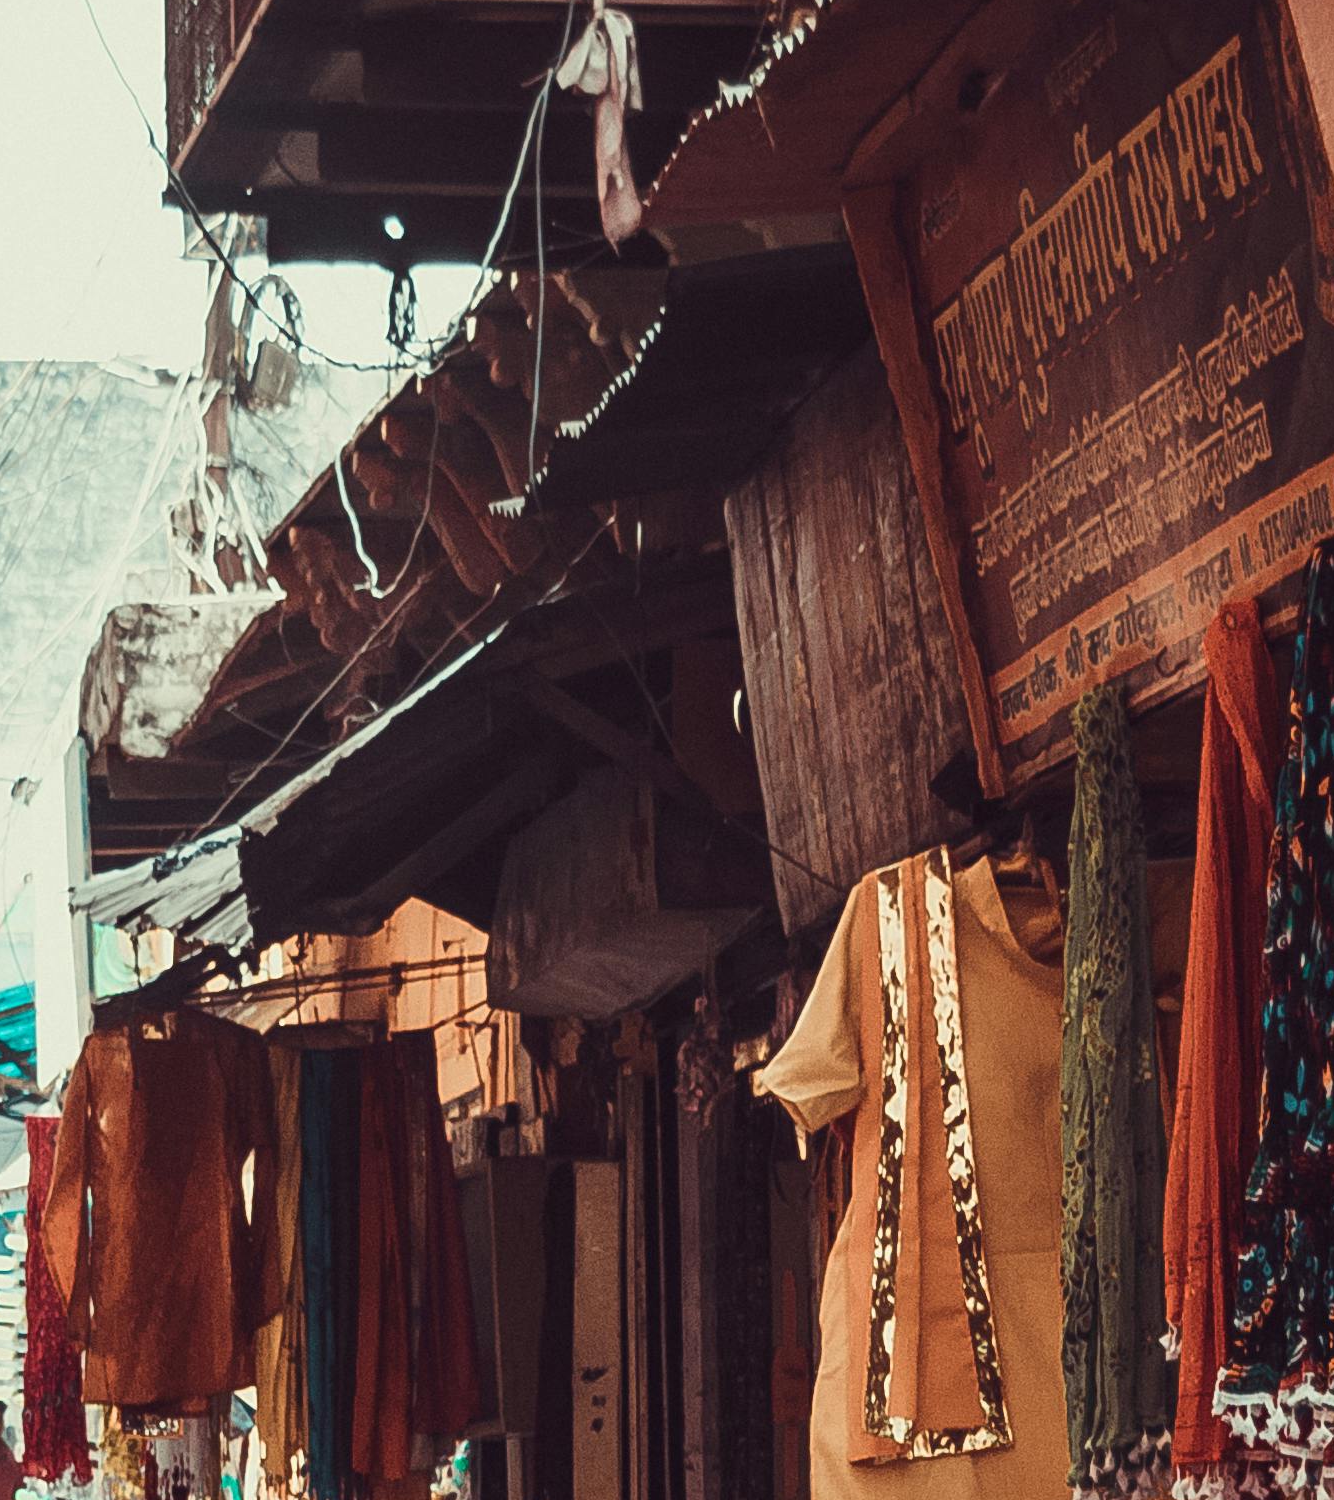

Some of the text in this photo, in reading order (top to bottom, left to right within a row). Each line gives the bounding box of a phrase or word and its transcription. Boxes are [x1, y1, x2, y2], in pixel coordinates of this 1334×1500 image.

[1119, 106, 1182, 266] वस्त्र
[1165, 36, 1265, 222] भण्डार
[999, 680, 1029, 724] नन्द
[1060, 626, 1087, 679] श्री
